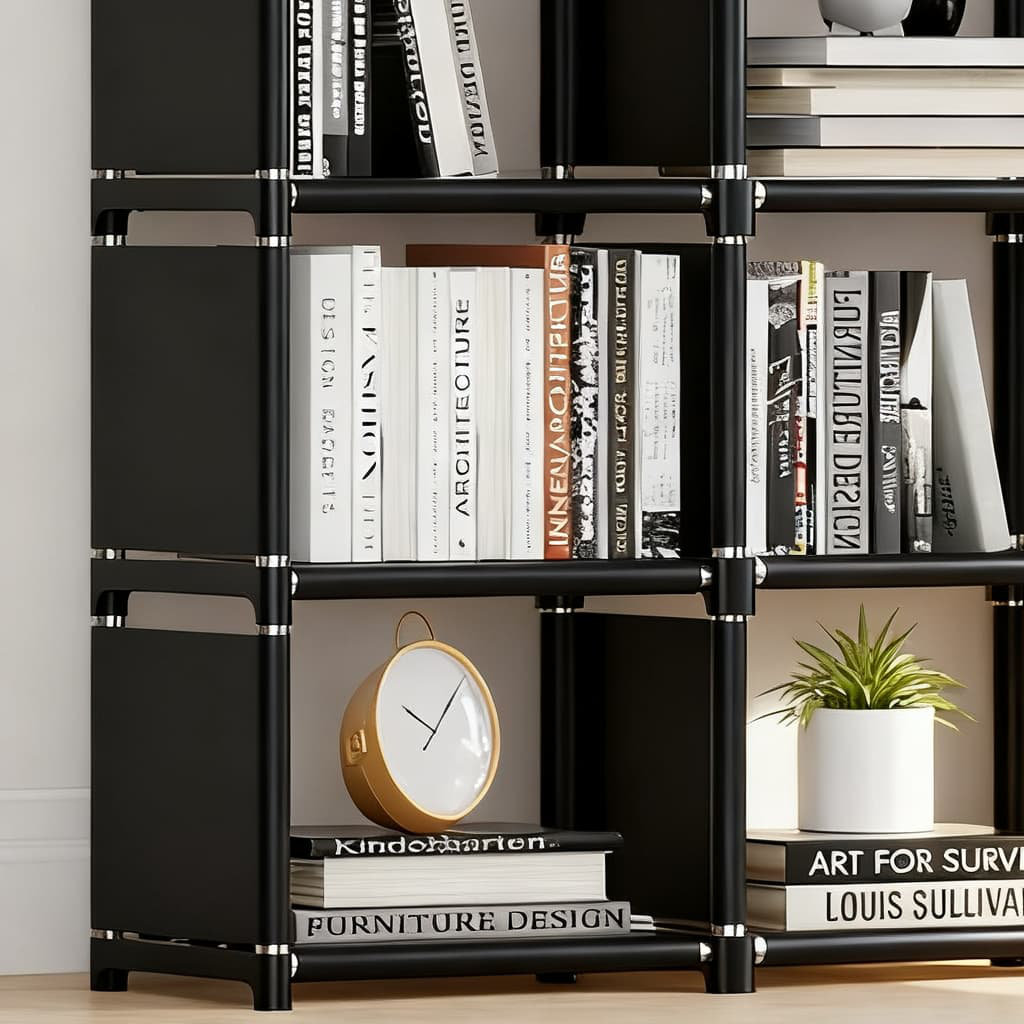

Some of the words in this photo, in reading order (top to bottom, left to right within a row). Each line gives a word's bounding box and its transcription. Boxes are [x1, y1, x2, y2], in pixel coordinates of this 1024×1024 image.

[808, 850, 865, 877] ART
[874, 848, 934, 875] FOR
[826, 889, 904, 923] LOUIS
[307, 911, 496, 937] FURNITURE
[508, 907, 625, 931] DESIGN
